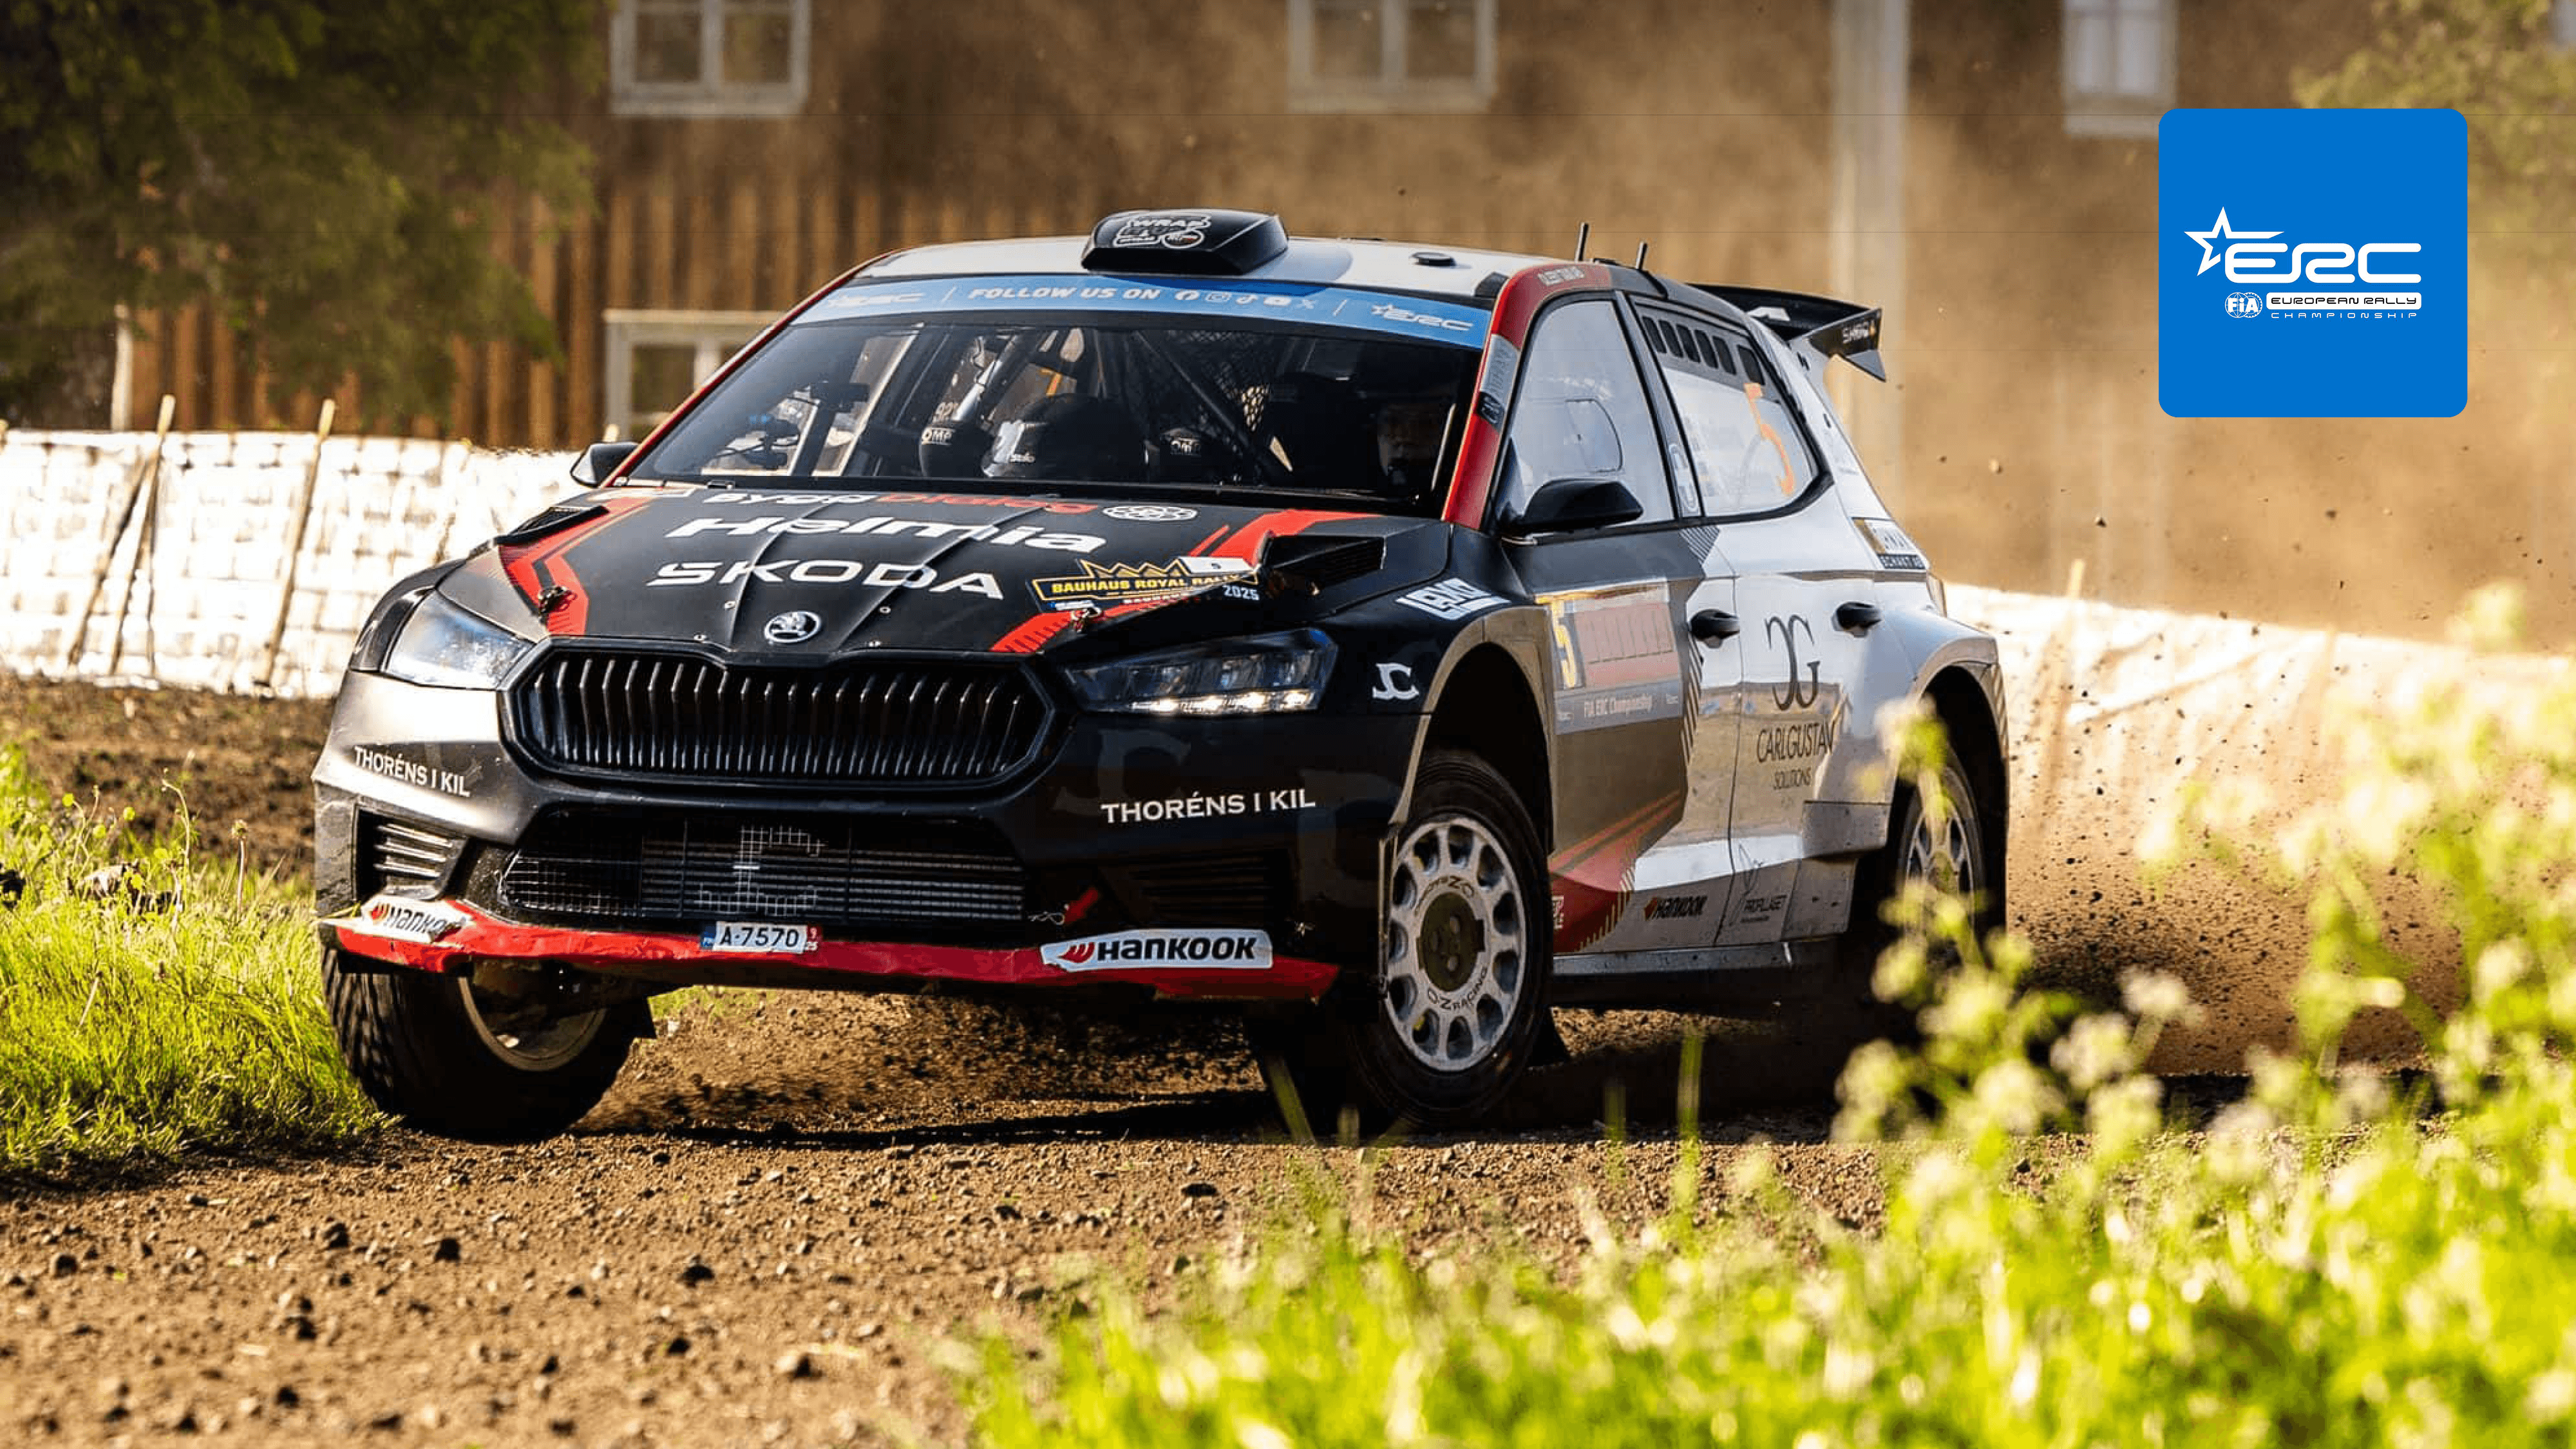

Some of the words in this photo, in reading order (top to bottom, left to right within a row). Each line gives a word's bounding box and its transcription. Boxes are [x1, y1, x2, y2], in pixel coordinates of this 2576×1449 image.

[968, 287, 1076, 299] FOLLOW
[1080, 287, 1117, 299] US
[1122, 289, 1161, 300] ON
[665, 516, 1107, 553] Helmia
[1050, 580, 1130, 594] BAUHAUS
[1135, 578, 1186, 589] ROYAL
[1224, 584, 1260, 601] 2025
[355, 746, 428, 786] THORÉNS
[441, 773, 471, 798] KIL
[1101, 791, 1246, 823] THORÉNS
[1254, 792, 1260, 812] I
[1269, 788, 1316, 811] KIL
